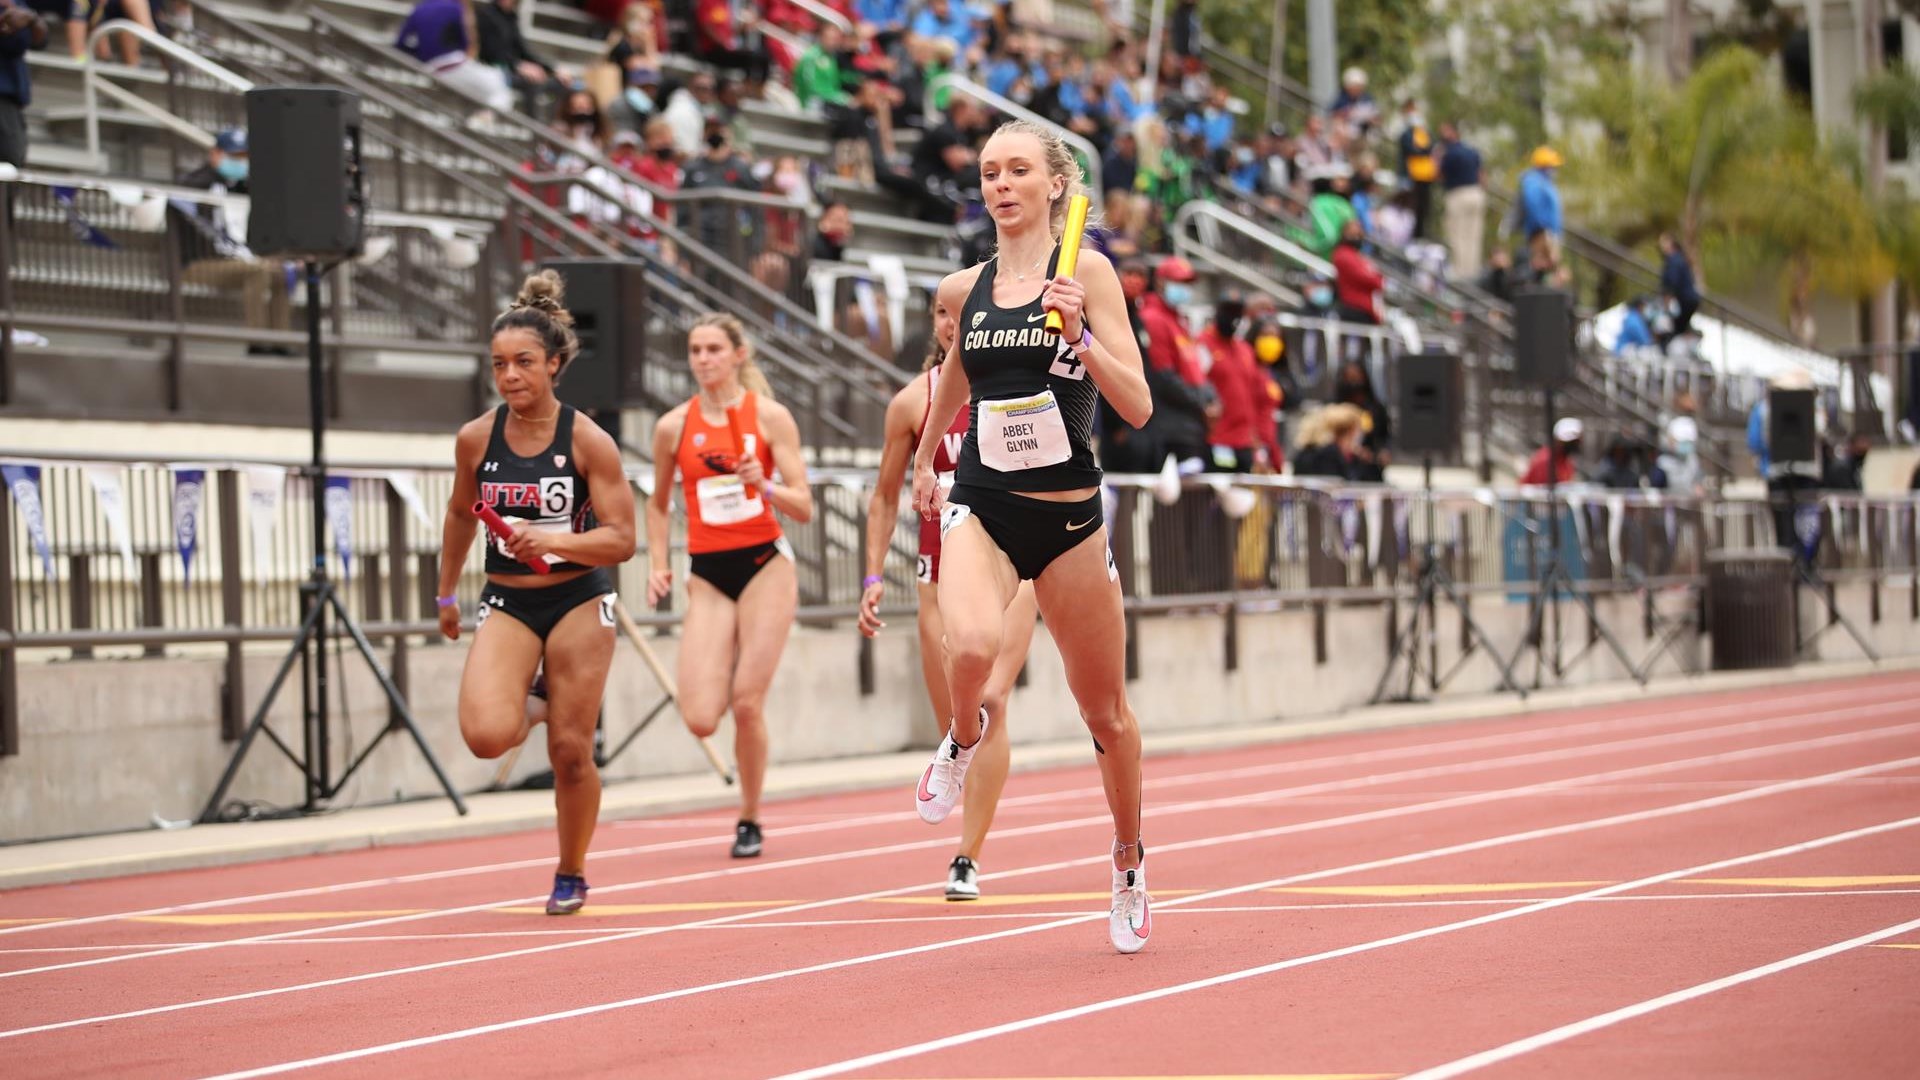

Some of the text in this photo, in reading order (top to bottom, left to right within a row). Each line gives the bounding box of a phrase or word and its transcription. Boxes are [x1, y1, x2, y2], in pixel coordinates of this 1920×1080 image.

[964, 328, 1057, 351] COLORADO
[1058, 346, 1081, 375] 4
[1003, 423, 1034, 438] ABBEY
[1007, 439, 1039, 453] GLYNN
[481, 482, 541, 508] UTA
[546, 481, 567, 513] 6
